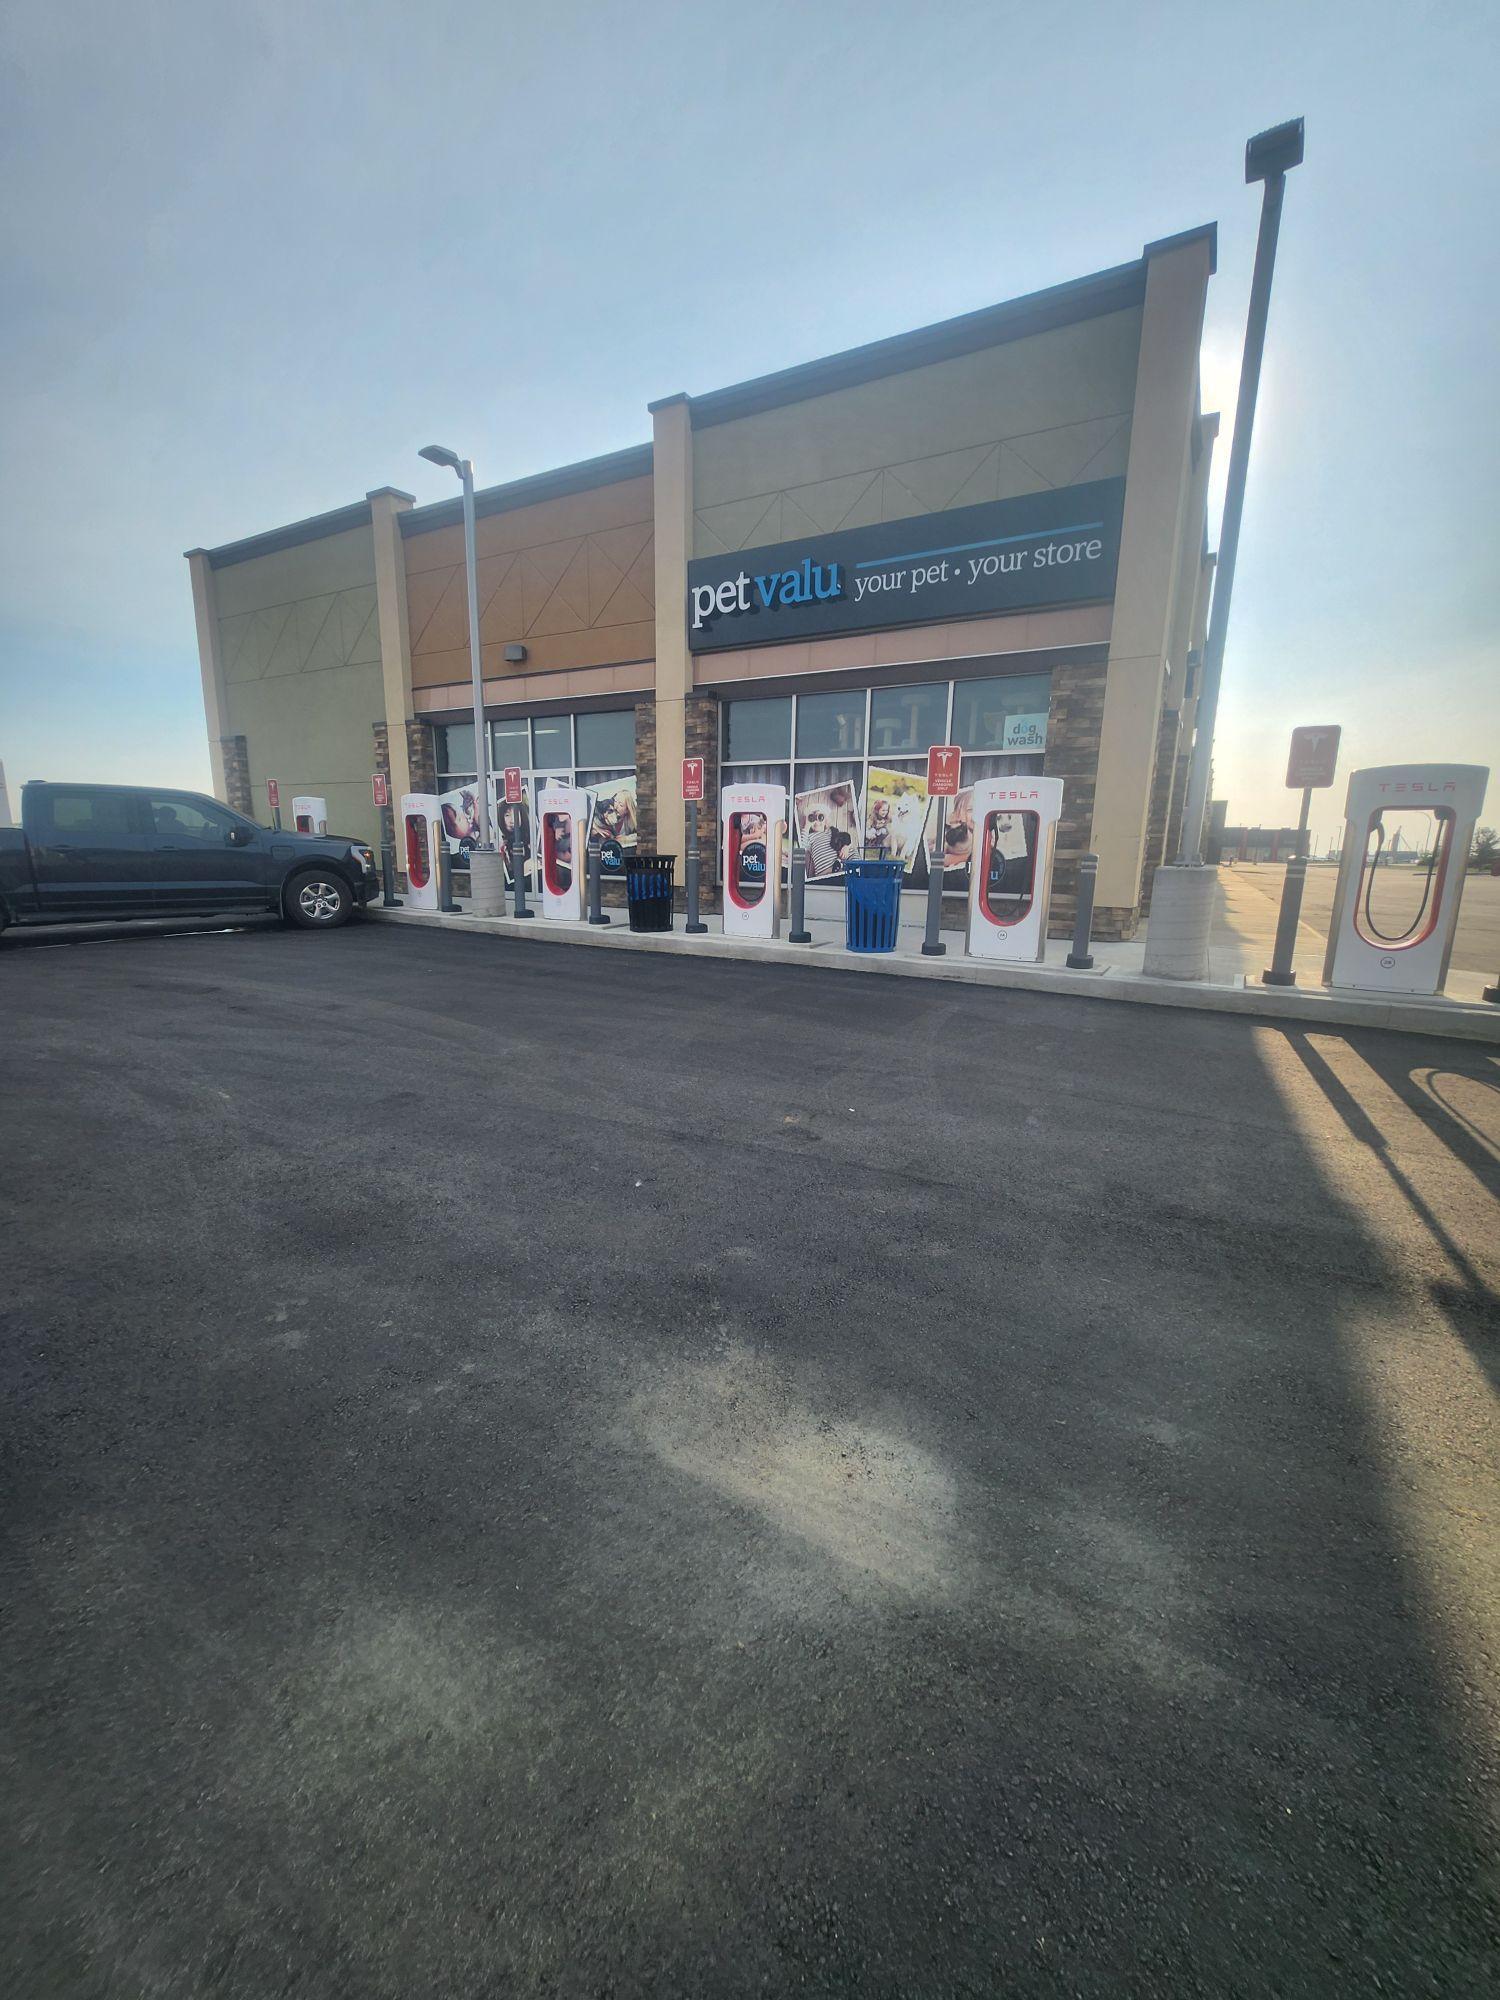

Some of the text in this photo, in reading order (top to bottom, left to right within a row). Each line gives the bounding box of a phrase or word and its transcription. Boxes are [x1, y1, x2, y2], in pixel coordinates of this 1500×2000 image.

[854, 539, 1102, 602] your pet your store
[691, 557, 841, 629] pet valu
[1012, 723, 1037, 736] dog
[1007, 733, 1043, 746] wash
[1379, 781, 1457, 793] TESLA
[730, 795, 766, 803] TESLA
[988, 791, 1038, 800] TESLA
[601, 850, 614, 861] pet
[605, 856, 621, 866] valu
[742, 854, 758, 866] pet
[747, 861, 766, 872] valu
